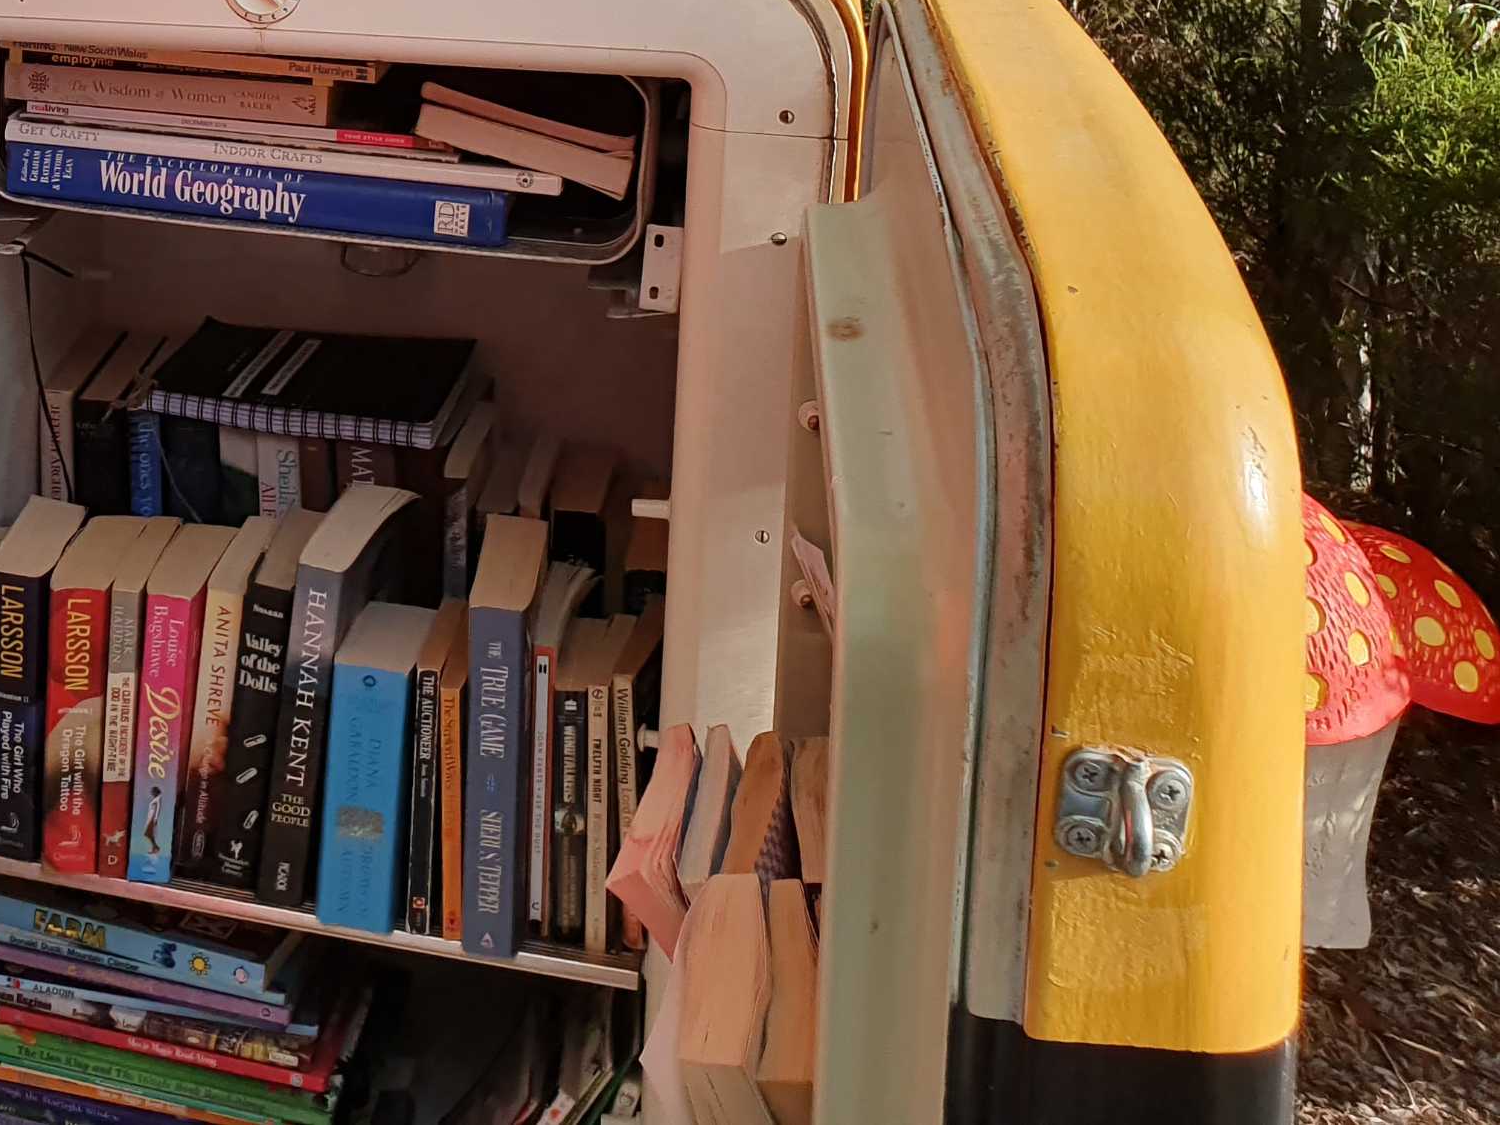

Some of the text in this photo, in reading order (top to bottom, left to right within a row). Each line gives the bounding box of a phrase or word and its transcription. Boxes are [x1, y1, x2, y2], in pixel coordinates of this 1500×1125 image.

[92, 81, 150, 98] Wisdom
[171, 88, 226, 104] Women
[20, 123, 100, 141] GET CRAFTY
[107, 152, 136, 163] THE
[146, 156, 273, 180] ENCYCLOPEDIA
[214, 143, 323, 164] INDOOR CRAFTS
[100, 160, 306, 223] World Geography
[262, 483, 276, 503] All
[278, 449, 298, 505] Sheila
[0, 585, 24, 678] LARSSON
[64, 599, 92, 691] LARSSON
[112, 605, 124, 663] HADDON
[123, 617, 135, 655] MARK
[151, 605, 168, 677] Bagshawe
[166, 619, 184, 667] Louise
[244, 633, 283, 657] Valley
[206, 605, 231, 725] ANITA SHREVE
[241, 653, 280, 675] of the
[111, 687, 120, 701] DOG
[238, 669, 278, 693] Dolls
[286, 587, 328, 787] HANNAH KENT
[422, 675, 434, 696] THE
[480, 666, 508, 709] TRUE
[109, 715, 118, 727] THE
[120, 690, 131, 723] CURIOUS
[617, 689, 630, 735] William
[118, 725, 129, 757] INCIDENT
[144, 683, 181, 780] Desire
[420, 698, 434, 760] AUCTIONEER
[480, 714, 508, 759] GAME
[0, 711, 12, 800] Played with Fire
[14, 745, 23, 767] Girl
[60, 729, 73, 812] Dragon Tattoo
[72, 725, 86, 815] The Girl with the
[619, 737, 632, 785] Golding
[12, 769, 22, 794] Who
[592, 779, 602, 803] NIGHT
[272, 802, 310, 817] GOOD
[281, 793, 304, 805] THE
[622, 788, 633, 813] Lord
[271, 813, 309, 827] PEOPLE
[477, 865, 502, 913] TEPPER
[34, 908, 106, 949] FARM
[32, 983, 74, 998] ALADDIN
[17, 1045, 36, 1059] The
